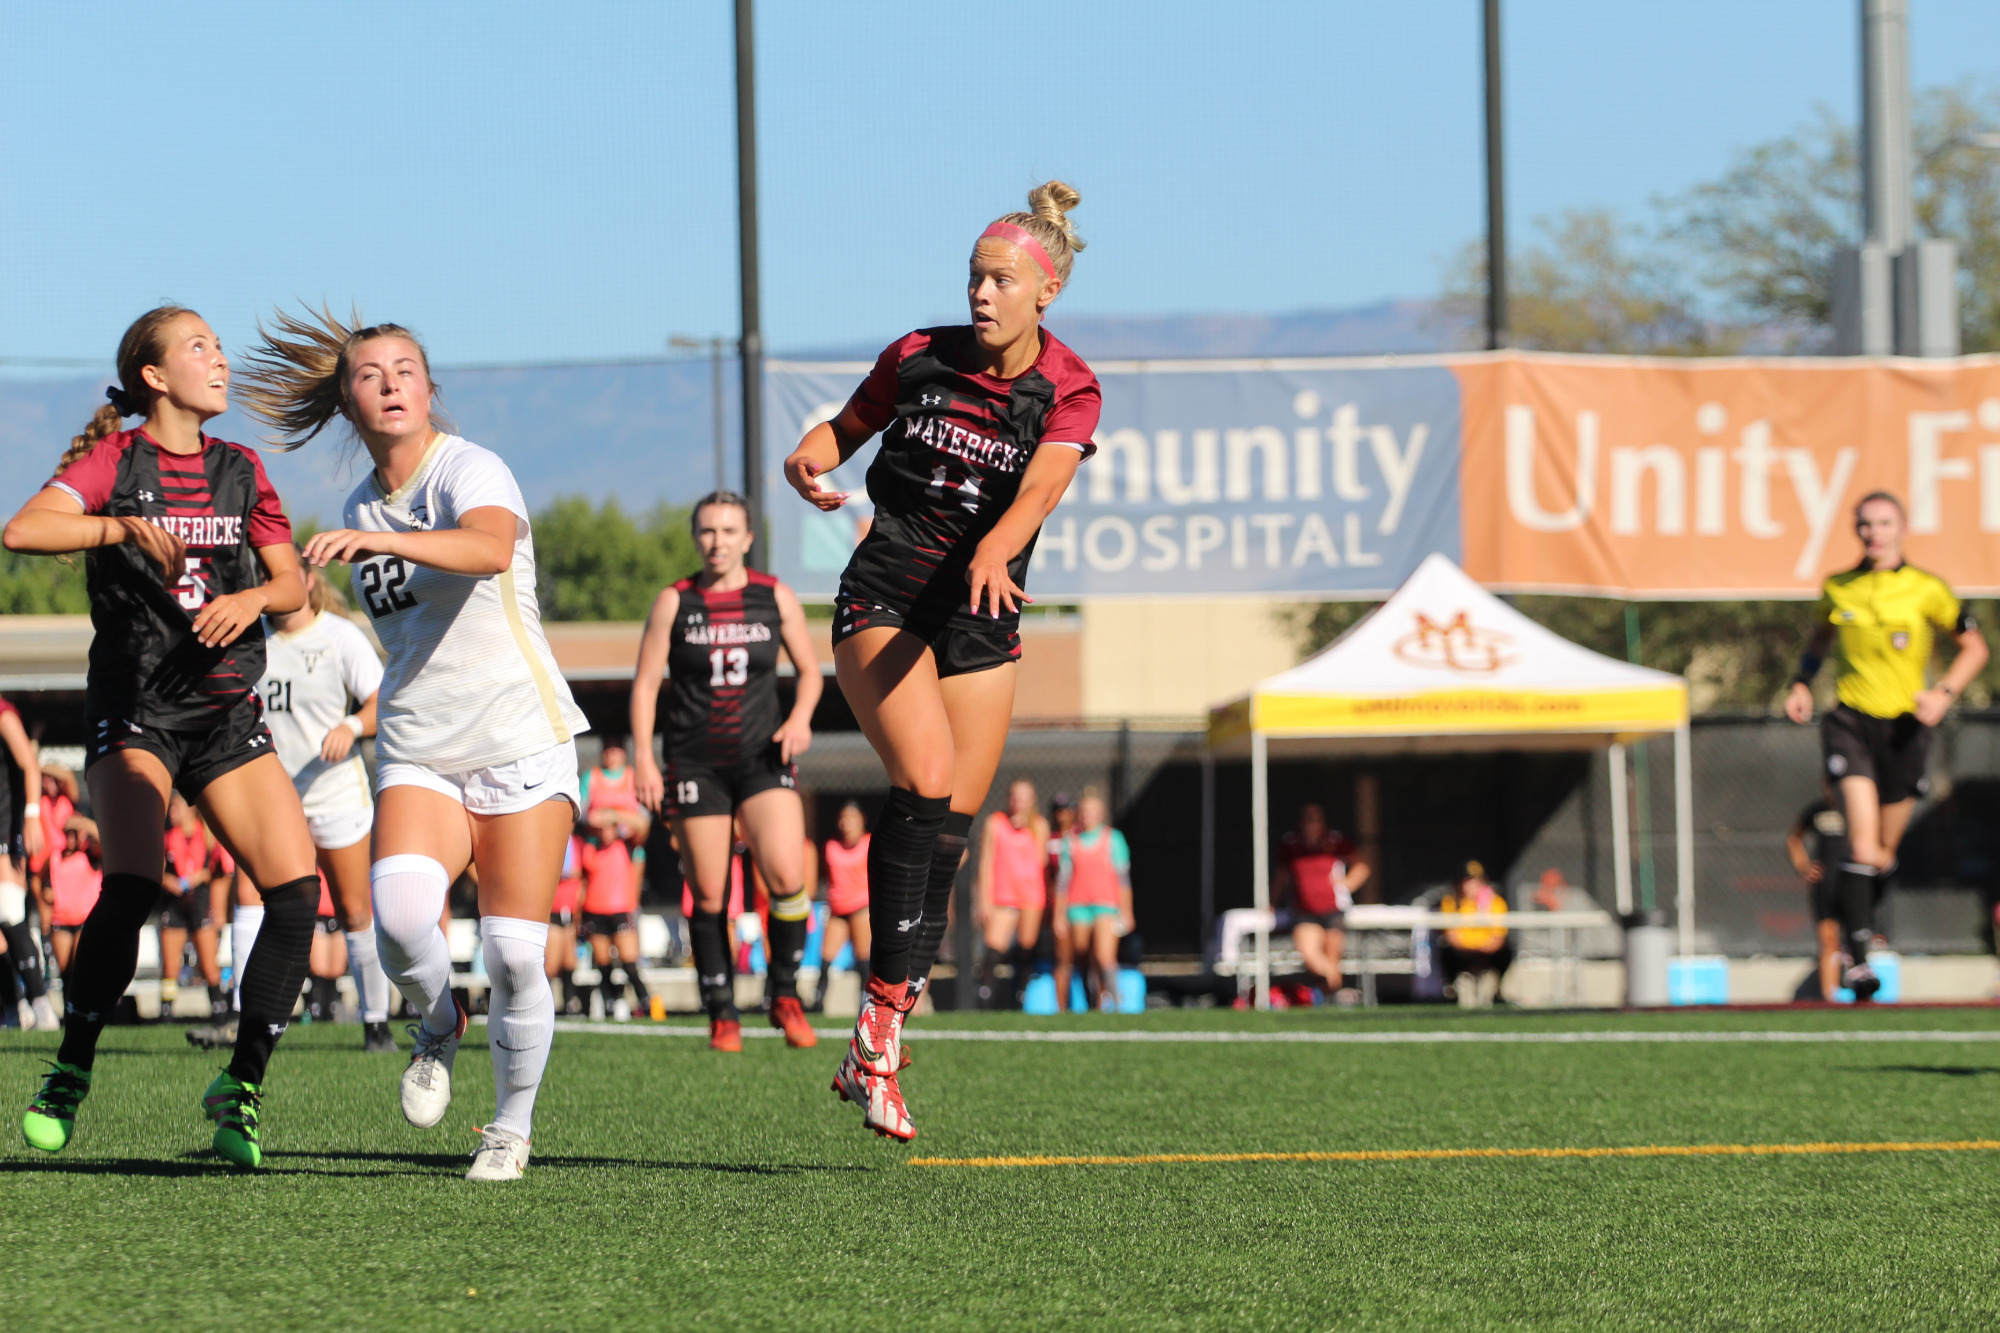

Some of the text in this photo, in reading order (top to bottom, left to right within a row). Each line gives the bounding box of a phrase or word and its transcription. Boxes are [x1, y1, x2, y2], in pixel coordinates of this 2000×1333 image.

[799, 389, 1430, 536] munity
[1504, 402, 1858, 581] Unity
[1031, 512, 1384, 573] HOSPITAL
[177, 556, 206, 610] 5
[359, 556, 419, 619] 22
[709, 647, 749, 687] 13
[266, 679, 292, 713] 21
[676, 780, 700, 804] 13
